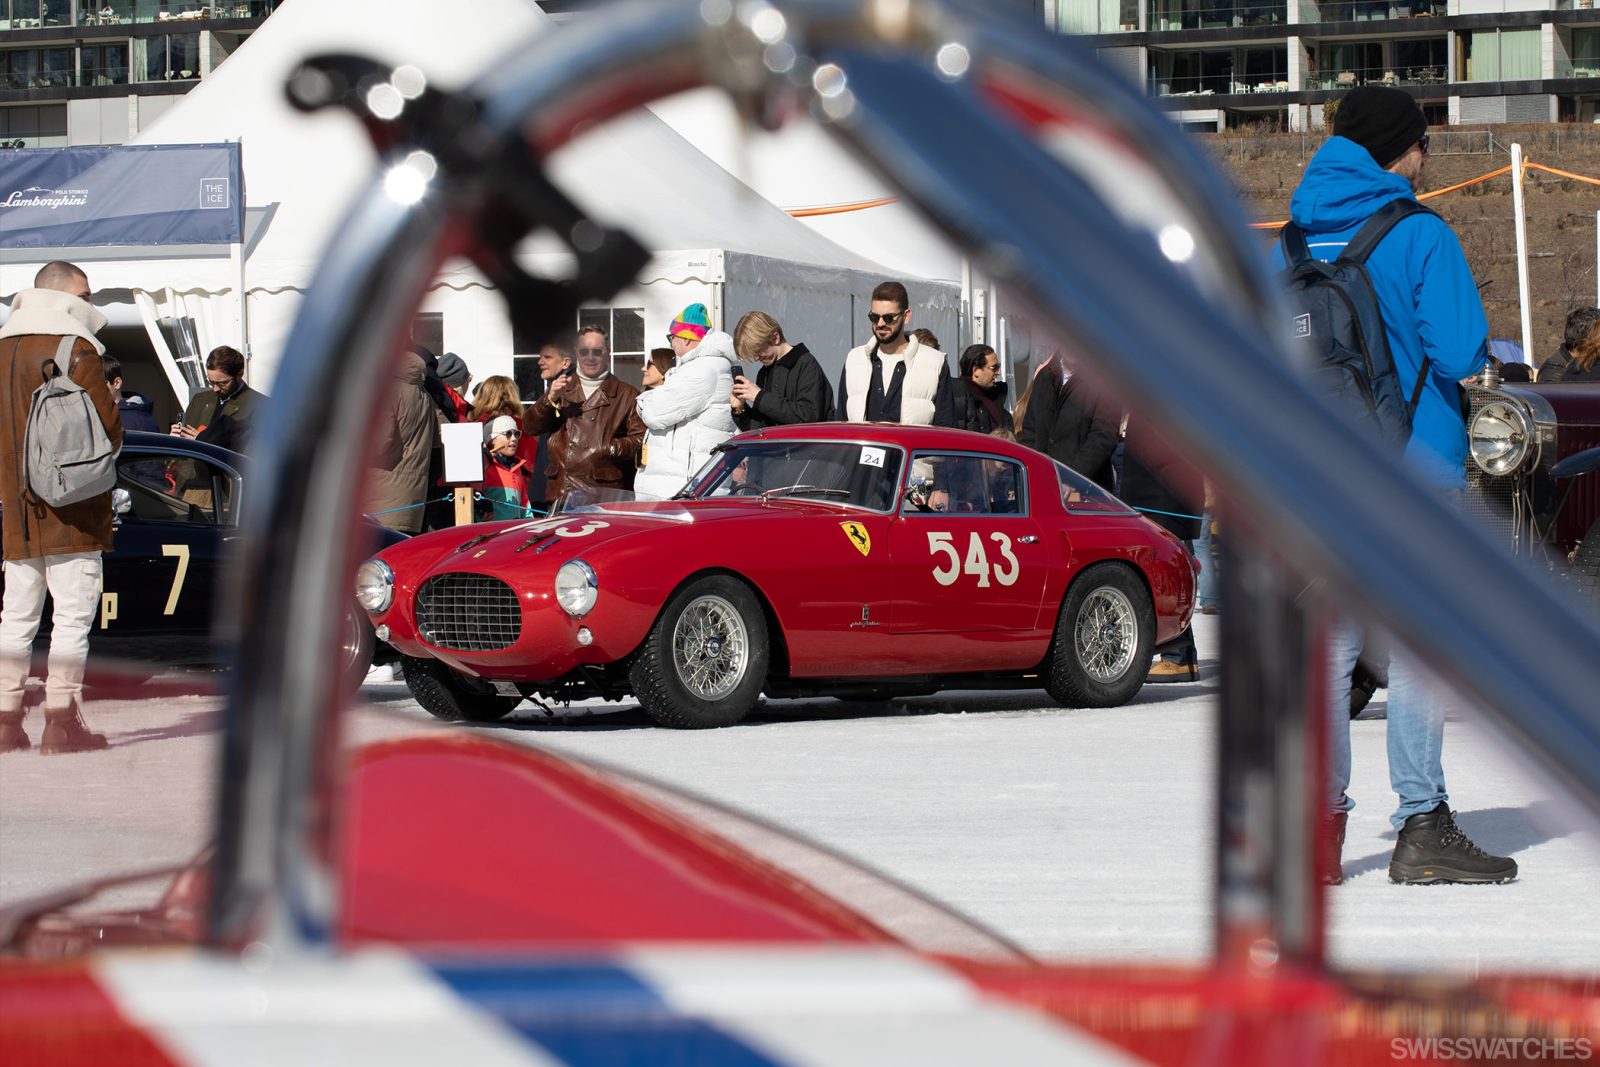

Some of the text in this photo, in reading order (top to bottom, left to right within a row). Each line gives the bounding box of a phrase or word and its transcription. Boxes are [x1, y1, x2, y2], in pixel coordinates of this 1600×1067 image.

[205, 184, 224, 193] THE
[0, 190, 88, 209] Lamborghini
[207, 194, 224, 203] ICE
[864, 453, 881, 465] 24
[926, 531, 1020, 588] 543
[161, 544, 190, 615] 7
